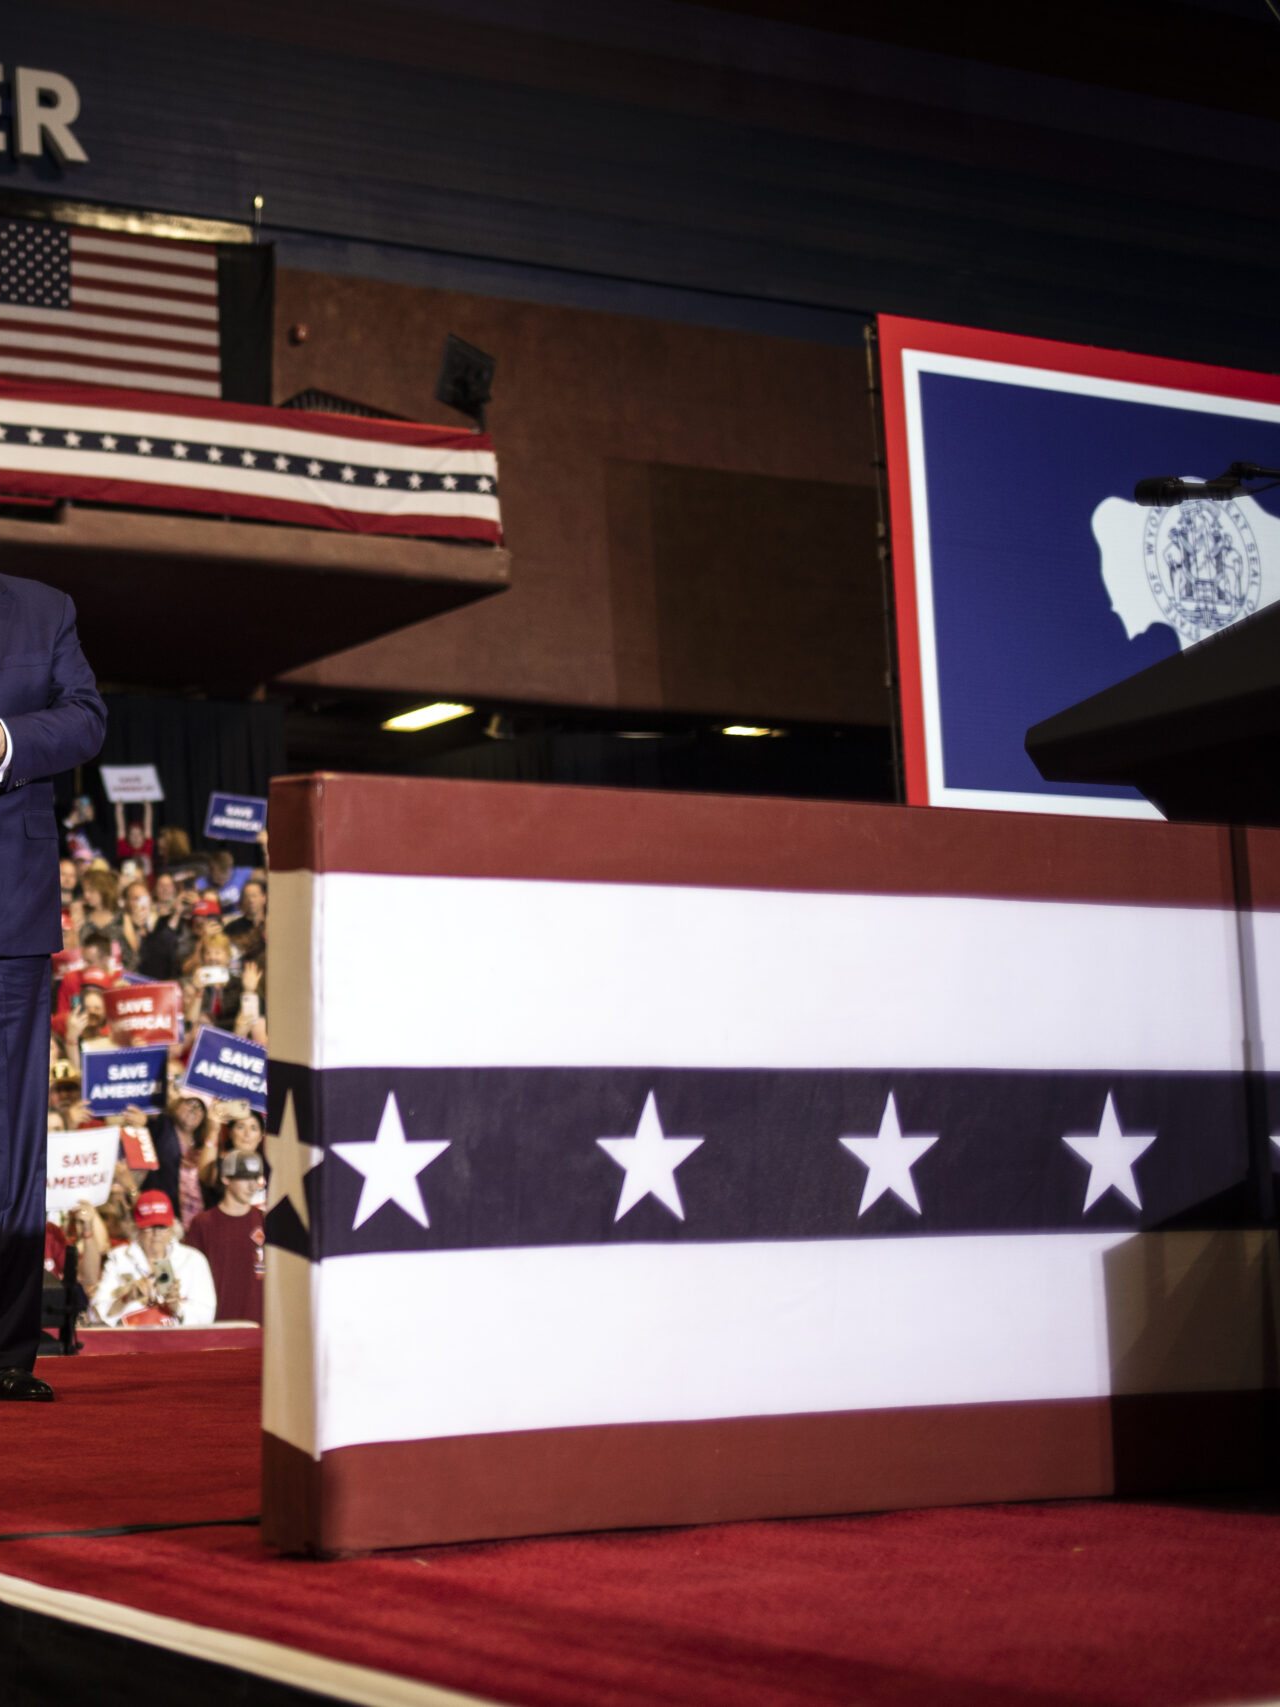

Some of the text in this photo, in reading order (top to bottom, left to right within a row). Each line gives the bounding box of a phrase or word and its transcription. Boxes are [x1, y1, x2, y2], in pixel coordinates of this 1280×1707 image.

[117, 997, 154, 1015] SAVE
[219, 1047, 265, 1075] SAVE
[108, 1063, 149, 1081] SAVE
[61, 1151, 98, 1168] SAVE
